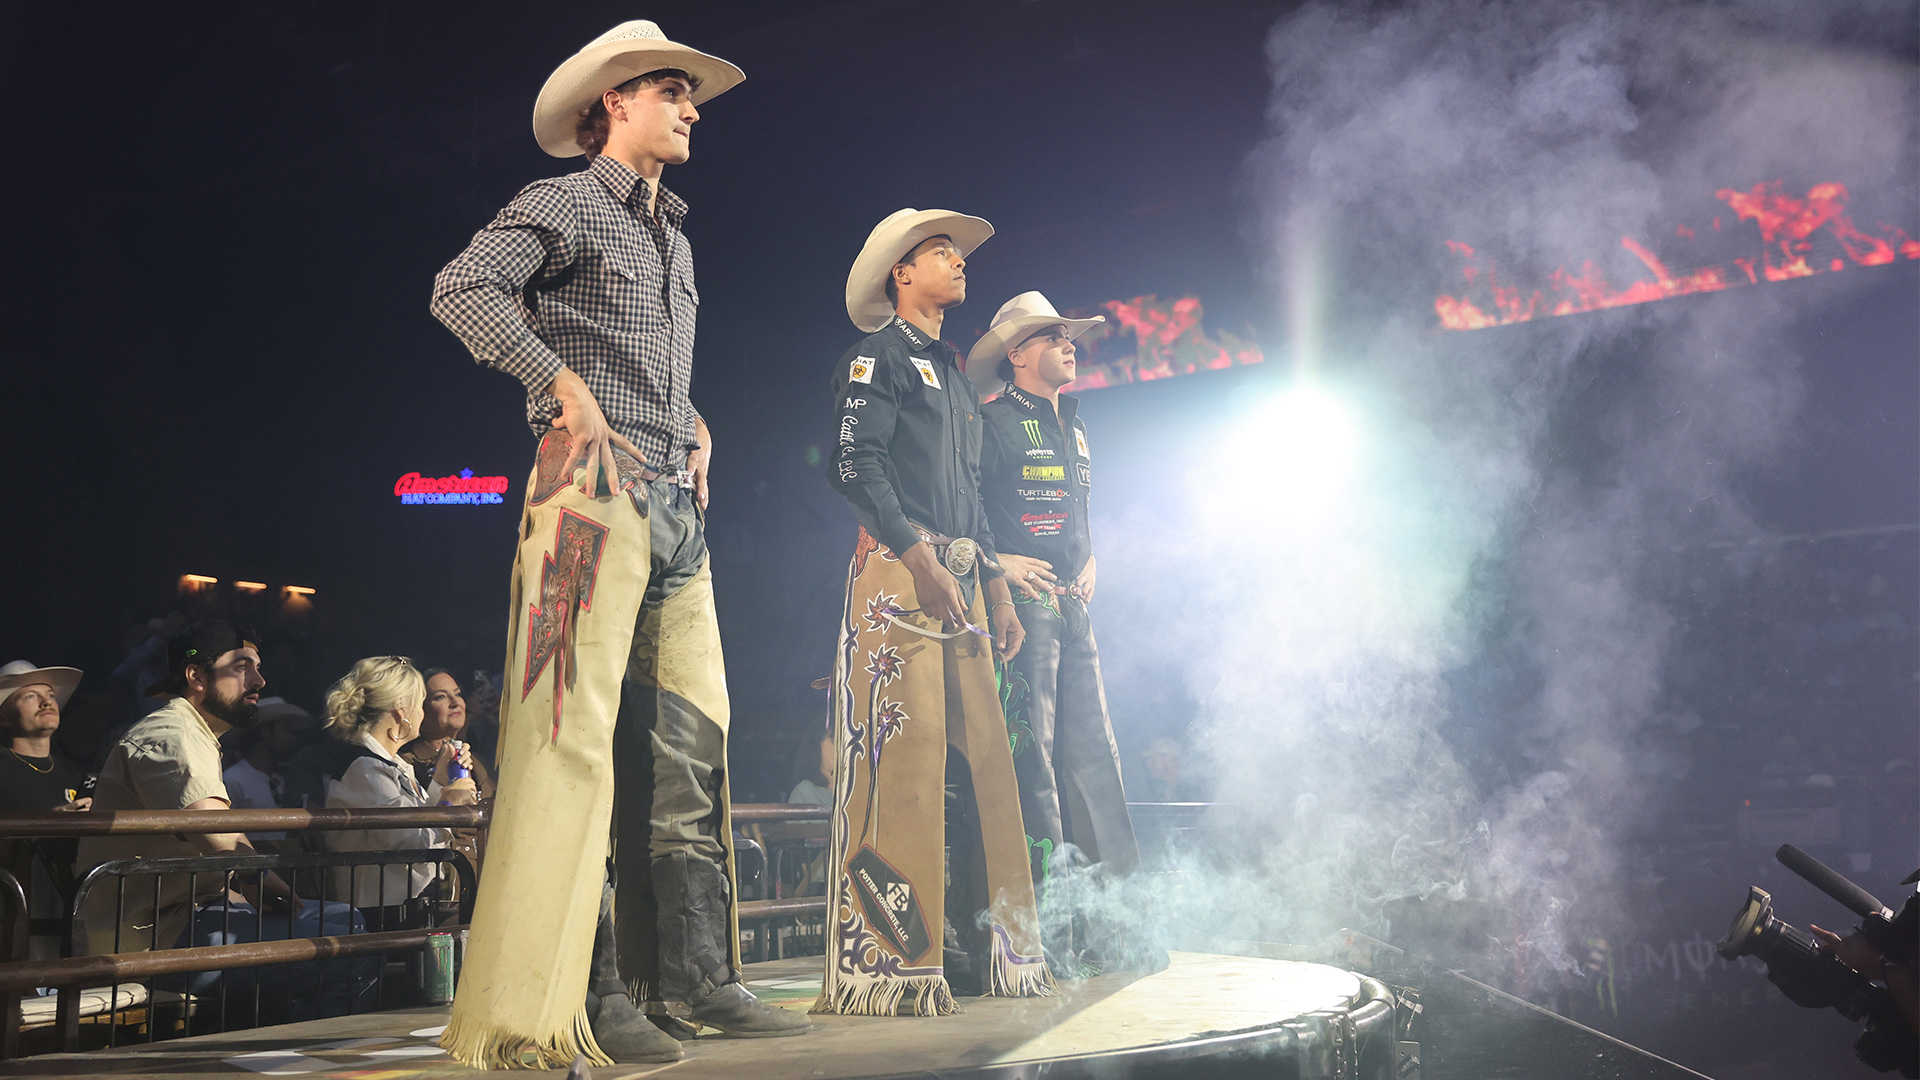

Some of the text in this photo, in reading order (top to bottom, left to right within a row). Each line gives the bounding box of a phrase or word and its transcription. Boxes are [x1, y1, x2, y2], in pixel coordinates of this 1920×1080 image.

[898, 323, 924, 346] ARIAT
[1010, 391, 1037, 410] ARIAT
[859, 868, 910, 942] POTTER CONCRETE, LLC
